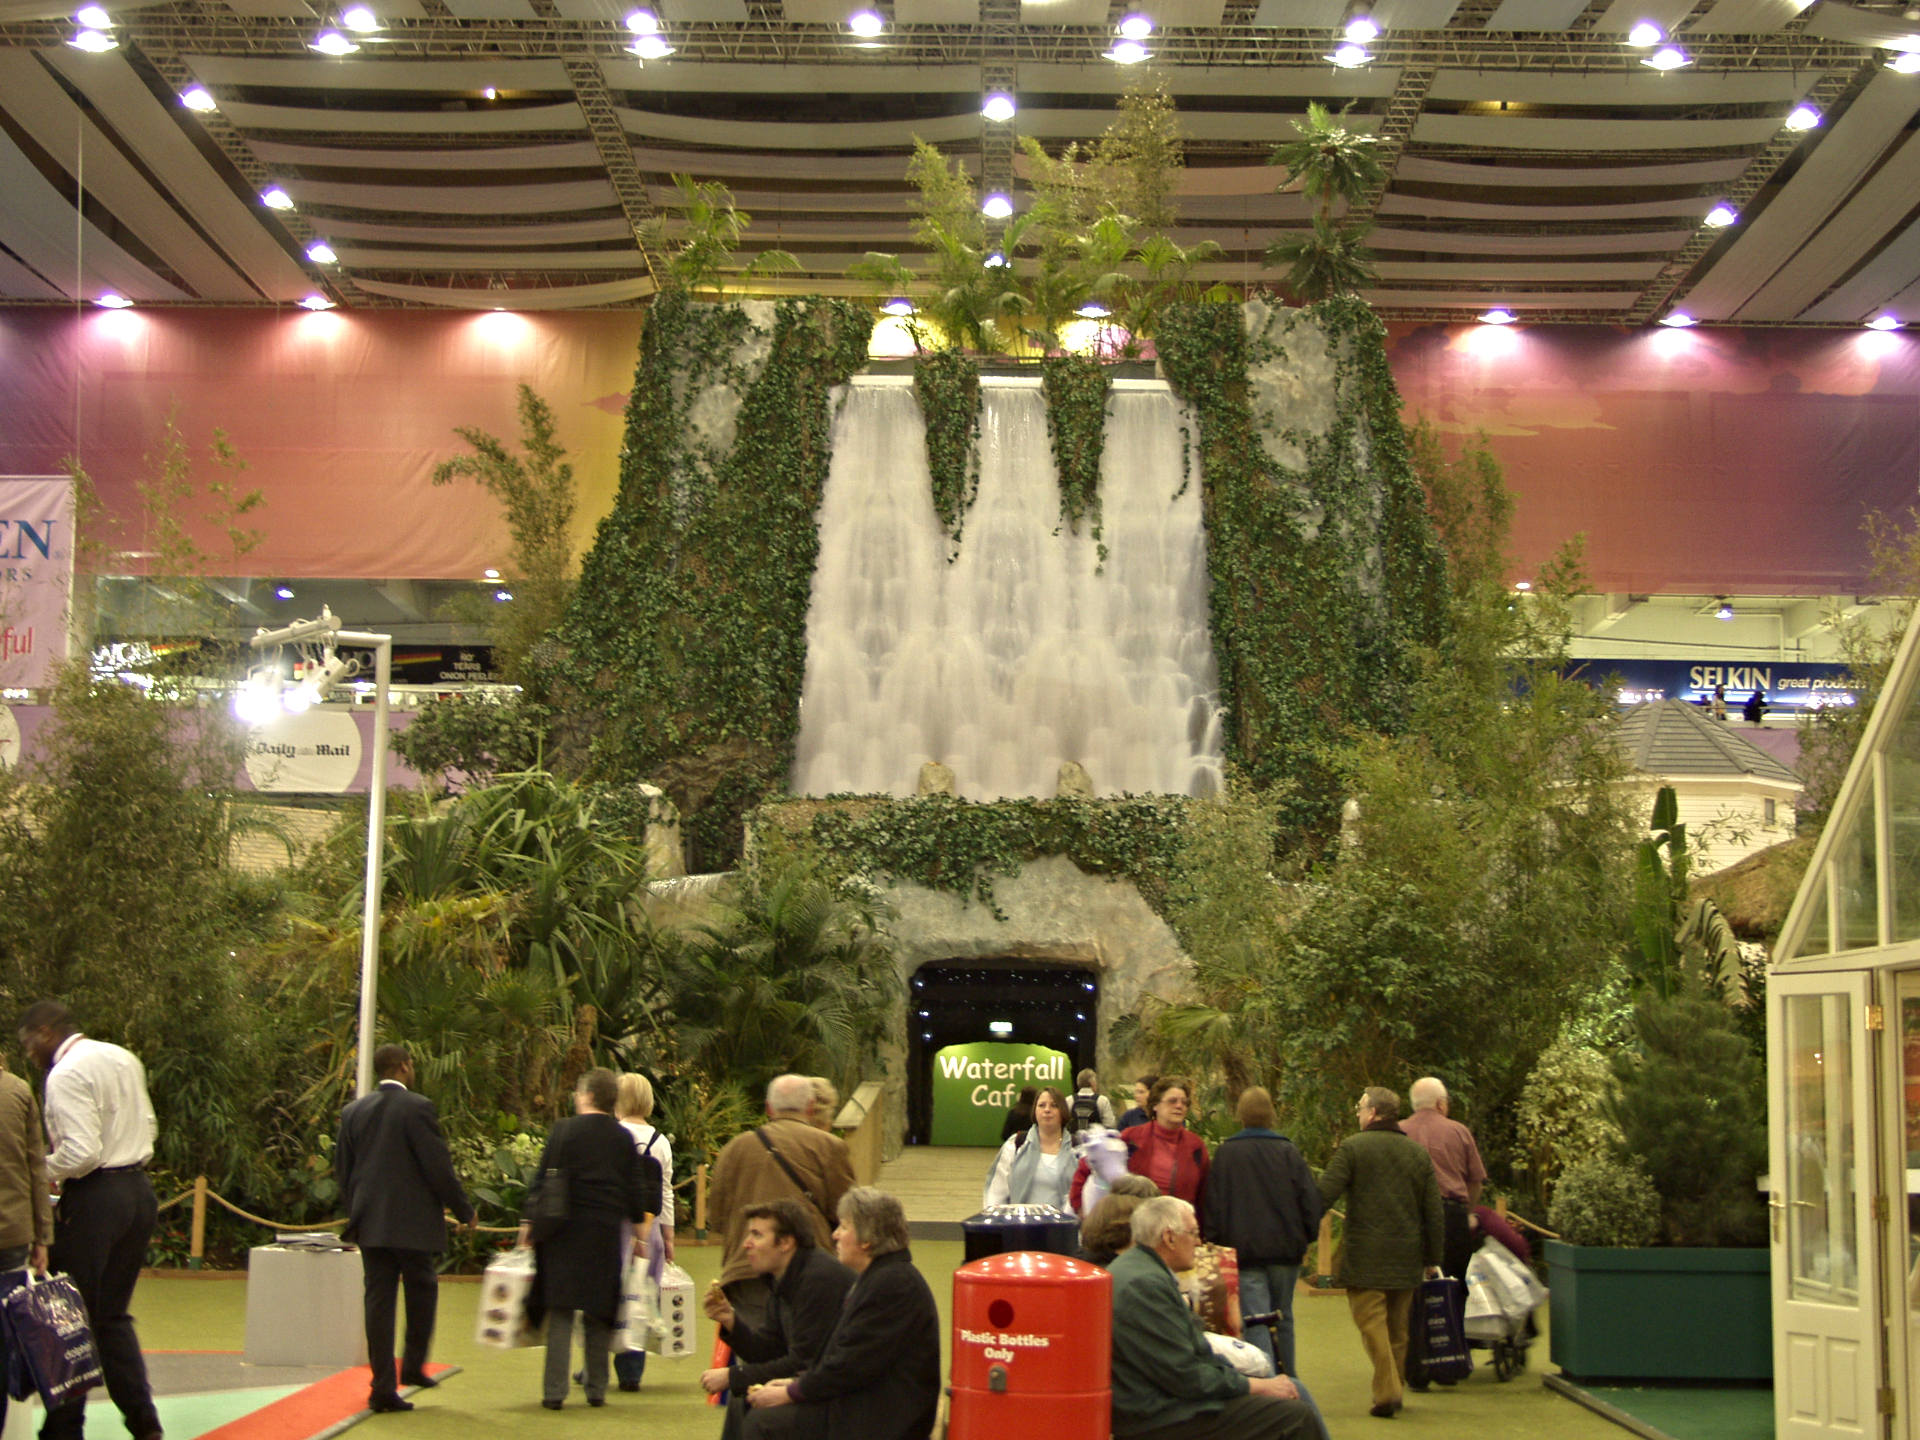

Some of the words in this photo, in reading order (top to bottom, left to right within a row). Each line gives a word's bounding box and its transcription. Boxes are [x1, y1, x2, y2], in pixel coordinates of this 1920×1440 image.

[0, 568, 32, 582] RS
[1690, 666, 1771, 690] SELKIN
[1777, 677, 1811, 690] great
[316, 744, 350, 756] Mail
[939, 1055, 1064, 1081] Waterfall
[971, 1083, 1020, 1107] Caf
[961, 1329, 997, 1345] Plastic
[999, 1333, 1050, 1347] Bottles
[984, 1346, 1015, 1363] Only
